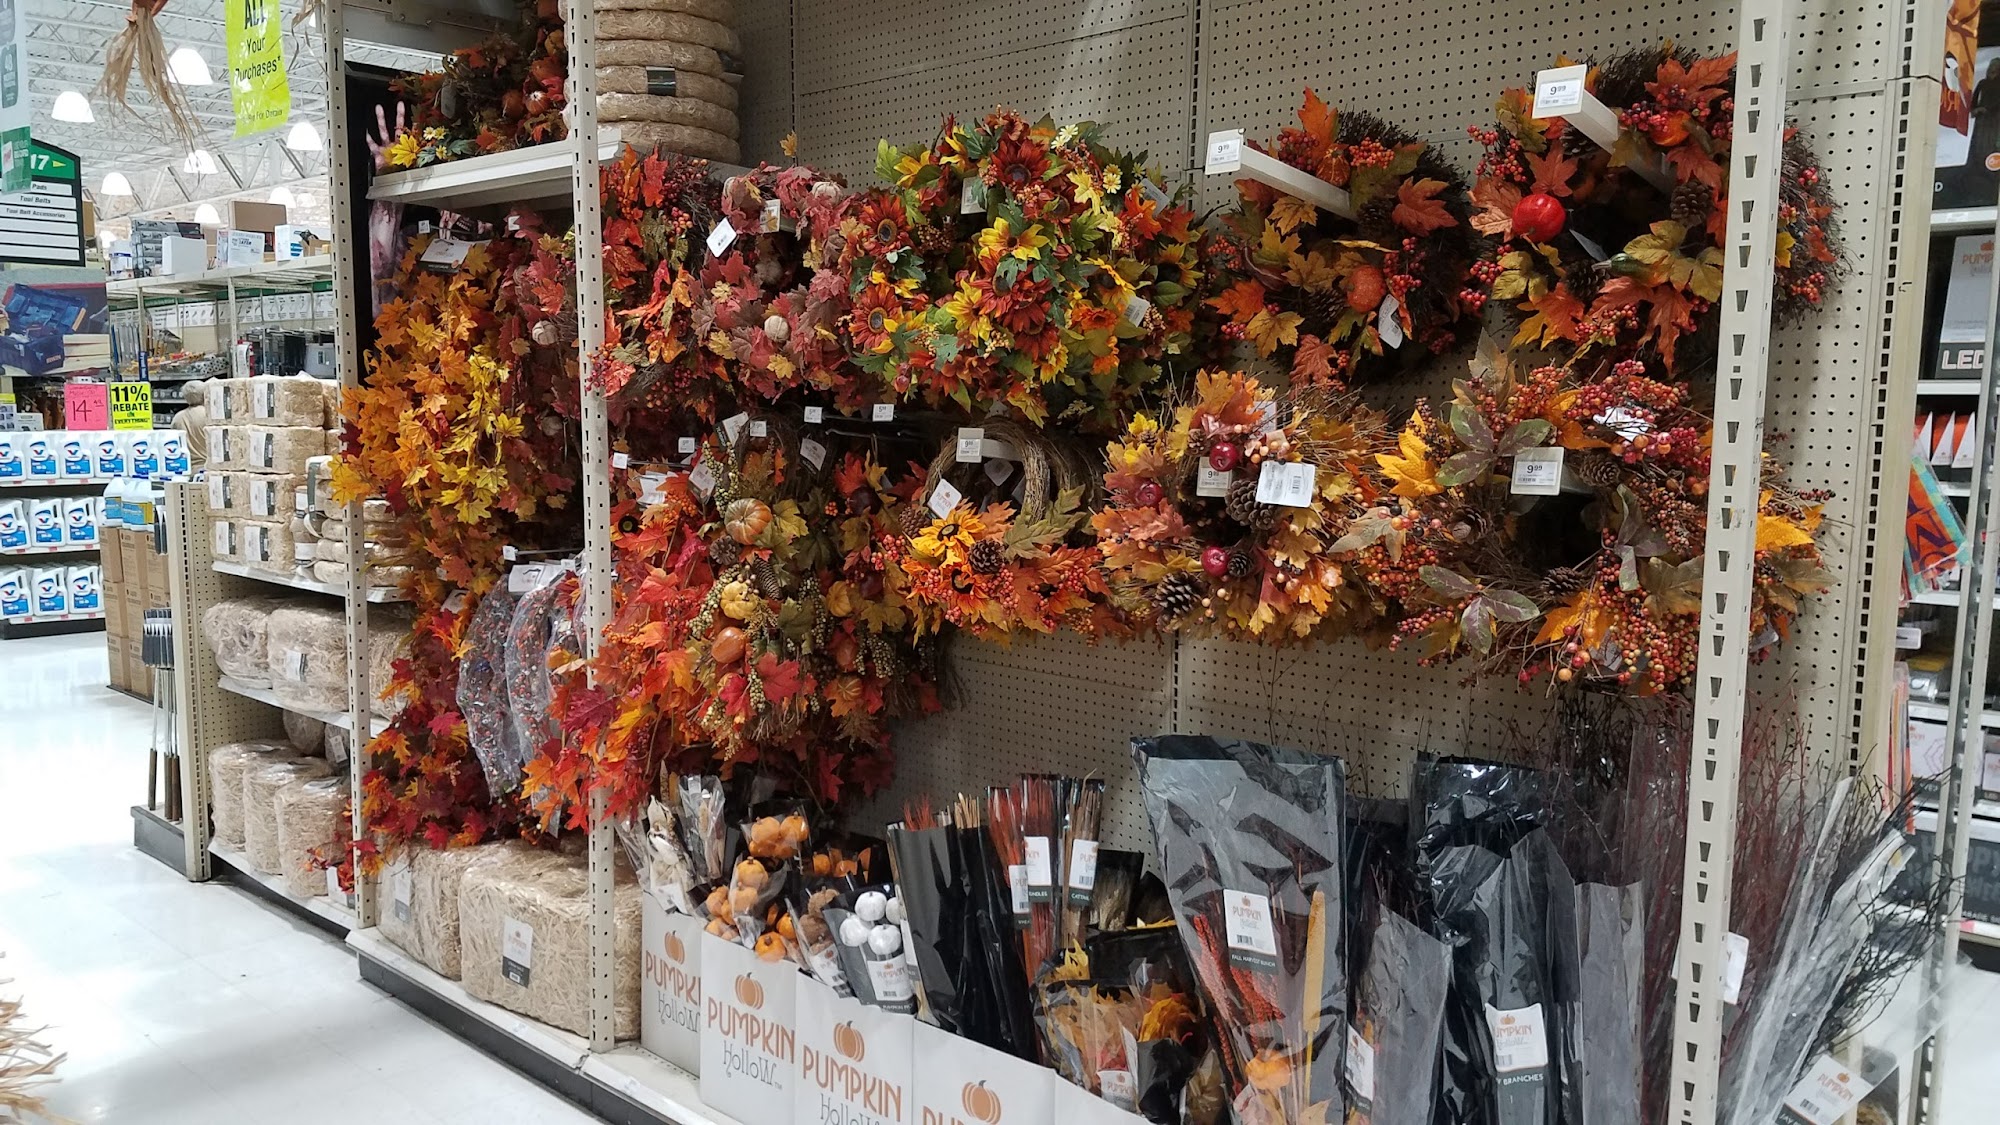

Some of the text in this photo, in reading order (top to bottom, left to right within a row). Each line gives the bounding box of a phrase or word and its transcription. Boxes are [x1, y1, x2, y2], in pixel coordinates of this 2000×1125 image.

[246, 37, 266, 54] Your
[30, 153, 50, 171] 17
[35, 196, 51, 204] Belts
[111, 385, 149, 402] 11%
[113, 403, 149, 412] REBATE
[645, 950, 701, 1006] PUMPKI
[708, 996, 795, 1064] PUMPKIN
[803, 1044, 901, 1122] PUMPKIN
[1503, 1073, 1544, 1085] BRANCHES
